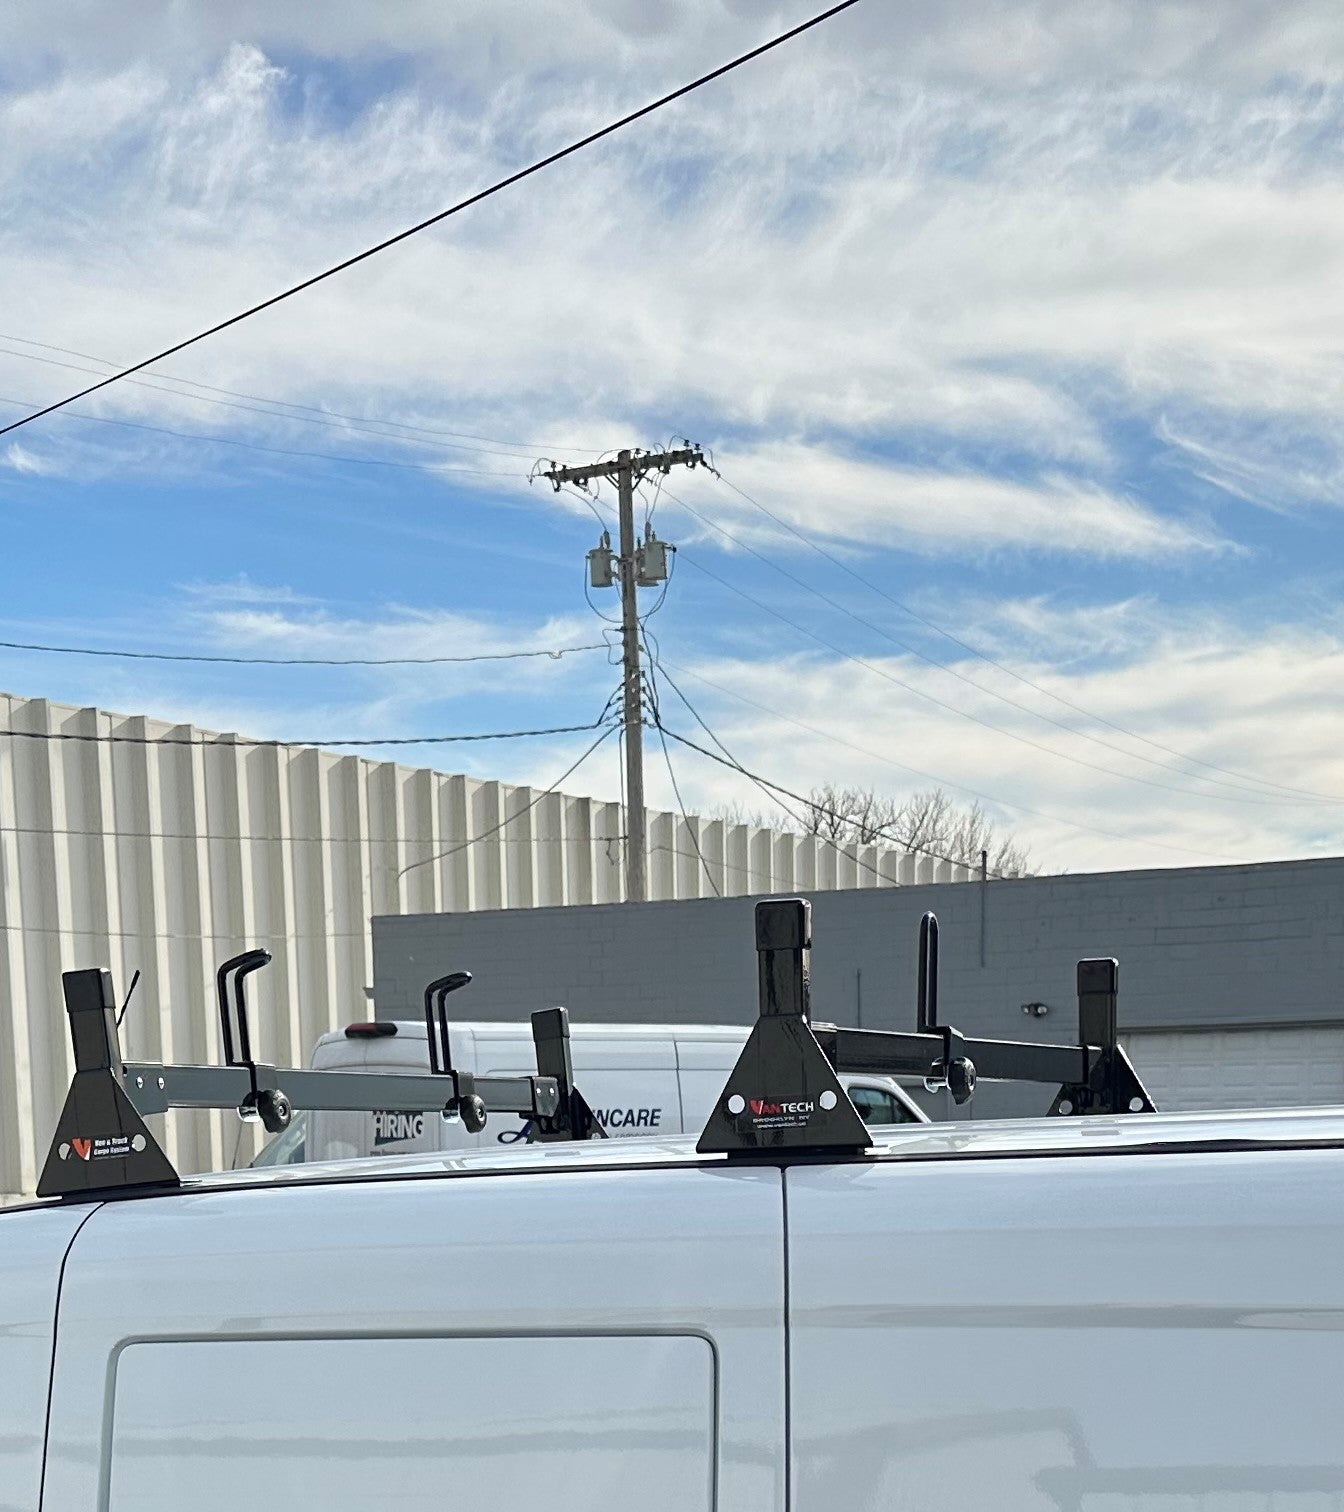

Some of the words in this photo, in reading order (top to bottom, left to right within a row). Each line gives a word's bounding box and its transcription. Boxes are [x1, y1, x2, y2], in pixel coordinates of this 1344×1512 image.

[750, 1099, 815, 1115] VANTECH
[374, 1111, 424, 1138] HIRING
[592, 1108, 662, 1128] NCARE
